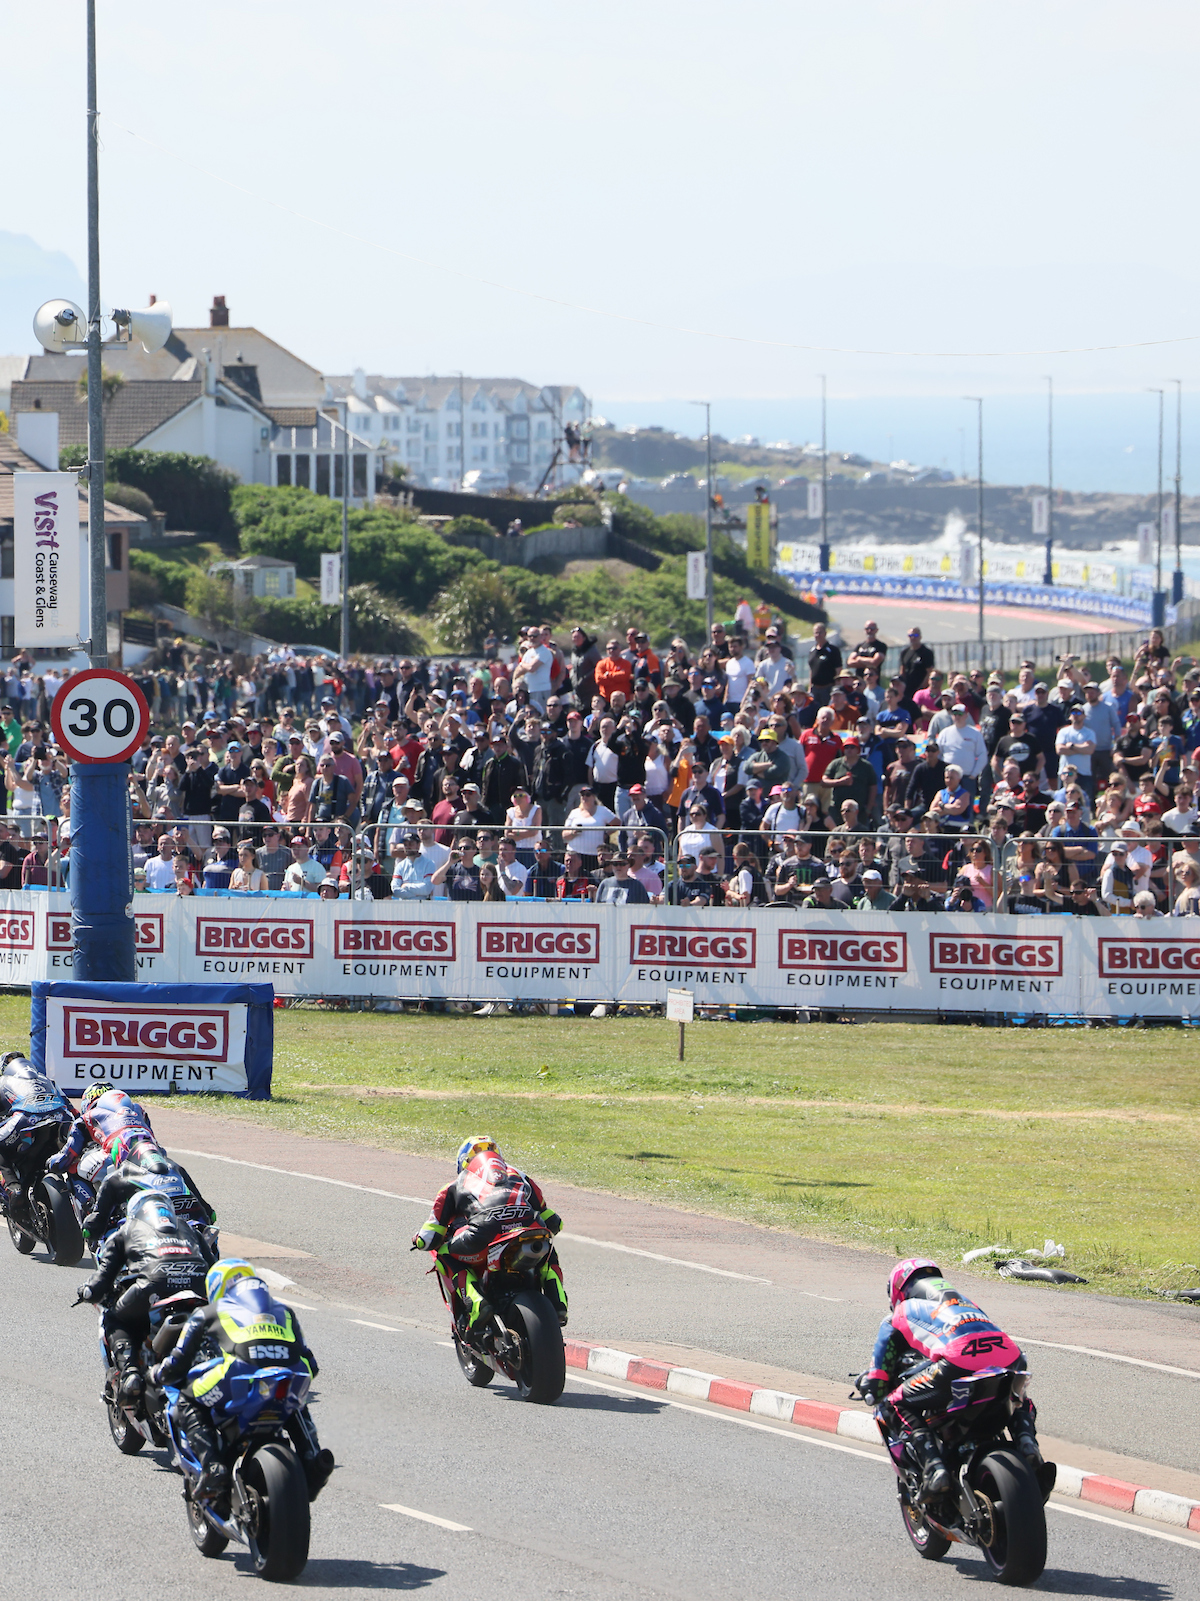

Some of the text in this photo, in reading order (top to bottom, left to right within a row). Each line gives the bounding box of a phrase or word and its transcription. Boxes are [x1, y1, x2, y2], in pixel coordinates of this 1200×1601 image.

[34, 491, 60, 550] Visit
[47, 552, 60, 610] Causeway
[35, 552, 47, 629] Coast & Glens
[68, 698, 134, 738] 30
[204, 926, 305, 950] BRIGGS
[343, 929, 449, 952] BRIGGS
[486, 932, 592, 955] BRIGGS
[638, 934, 748, 959] BRIGGS
[787, 939, 899, 964] BRIGGS
[939, 942, 1054, 968] BRIGGS
[203, 960, 306, 974] EQUIPMENT
[343, 963, 449, 977] EQUIPMENT
[486, 966, 592, 979] EQUIPMENT
[638, 969, 748, 984] EQUIPMENT
[787, 973, 900, 989] EQUIPMENT
[939, 977, 1055, 993] EQUIPMENT
[1108, 982, 1200, 995] EQUIPME
[75, 1018, 218, 1050] BRIGGS
[74, 1063, 218, 1081] EQUIPMENT
[171, 1198, 199, 1210] ST
[484, 1205, 532, 1222] RST
[160, 1247, 191, 1255] MOTUL
[151, 1261, 206, 1274] RST
[246, 1324, 286, 1336] YAMAHA
